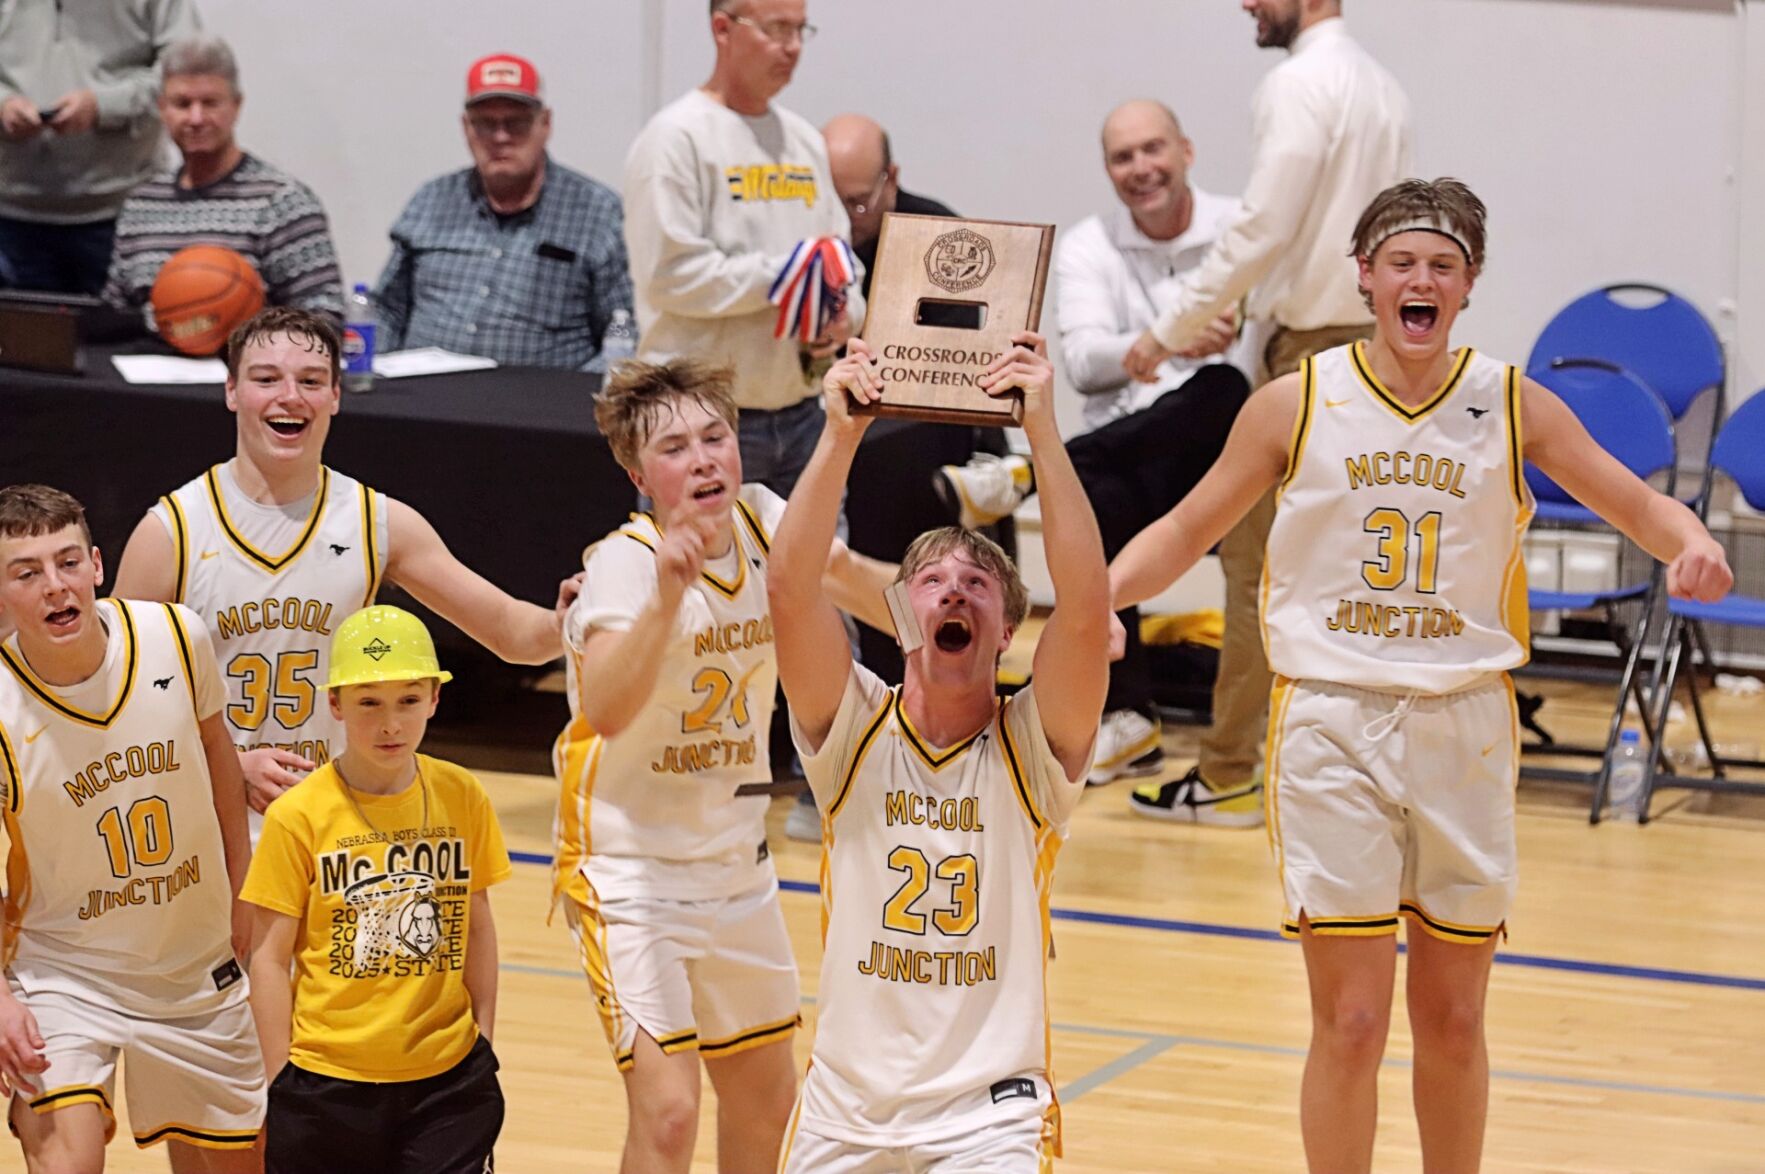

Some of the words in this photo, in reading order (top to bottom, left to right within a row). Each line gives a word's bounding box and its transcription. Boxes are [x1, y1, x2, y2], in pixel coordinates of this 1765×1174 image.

[880, 366, 988, 387] CONFERENC
[1345, 451, 1466, 499] MCCOOL
[1361, 507, 1442, 594] 31
[217, 597, 333, 640] MCCOOL
[1326, 599, 1466, 638] JUNCTION
[227, 649, 319, 731] 35
[63, 740, 180, 807] MCCOOL
[886, 790, 984, 832] MCCOOL
[96, 795, 174, 878] 10
[336, 831, 388, 849] NEBRASKA
[393, 829, 418, 842] BOYS
[421, 826, 446, 838] CLASS
[388, 841, 470, 885] COOL
[78, 855, 200, 920] JUNCTION
[882, 845, 979, 936] 23
[394, 954, 463, 977] STTE
[858, 941, 996, 986] JUNCTION
